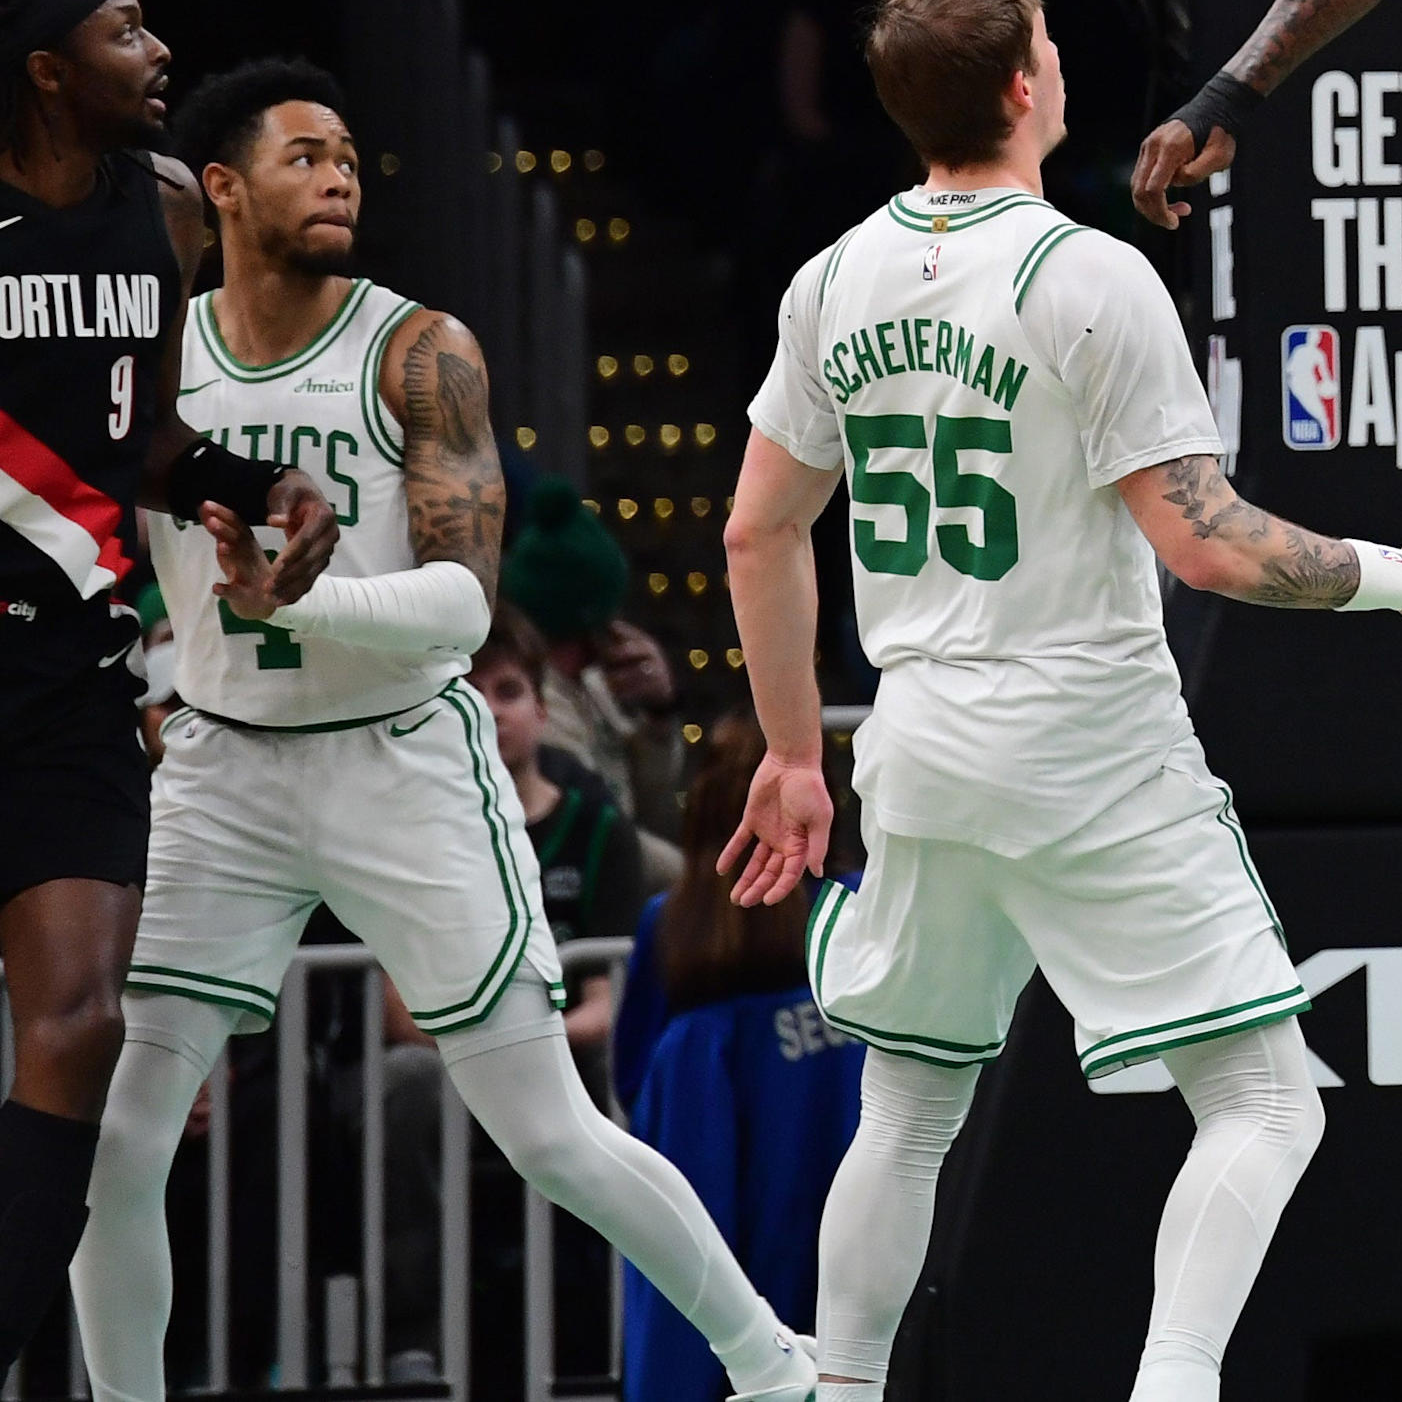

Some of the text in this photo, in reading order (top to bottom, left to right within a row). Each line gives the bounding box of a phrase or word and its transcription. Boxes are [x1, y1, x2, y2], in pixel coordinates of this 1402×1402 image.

[950, 194, 977, 205] PRO
[0, 274, 160, 339] ORTLAND
[108, 355, 135, 441] 9
[294, 378, 355, 394] Amica
[824, 318, 1029, 412] SCHEIERMAN
[845, 413, 1019, 582] 55
